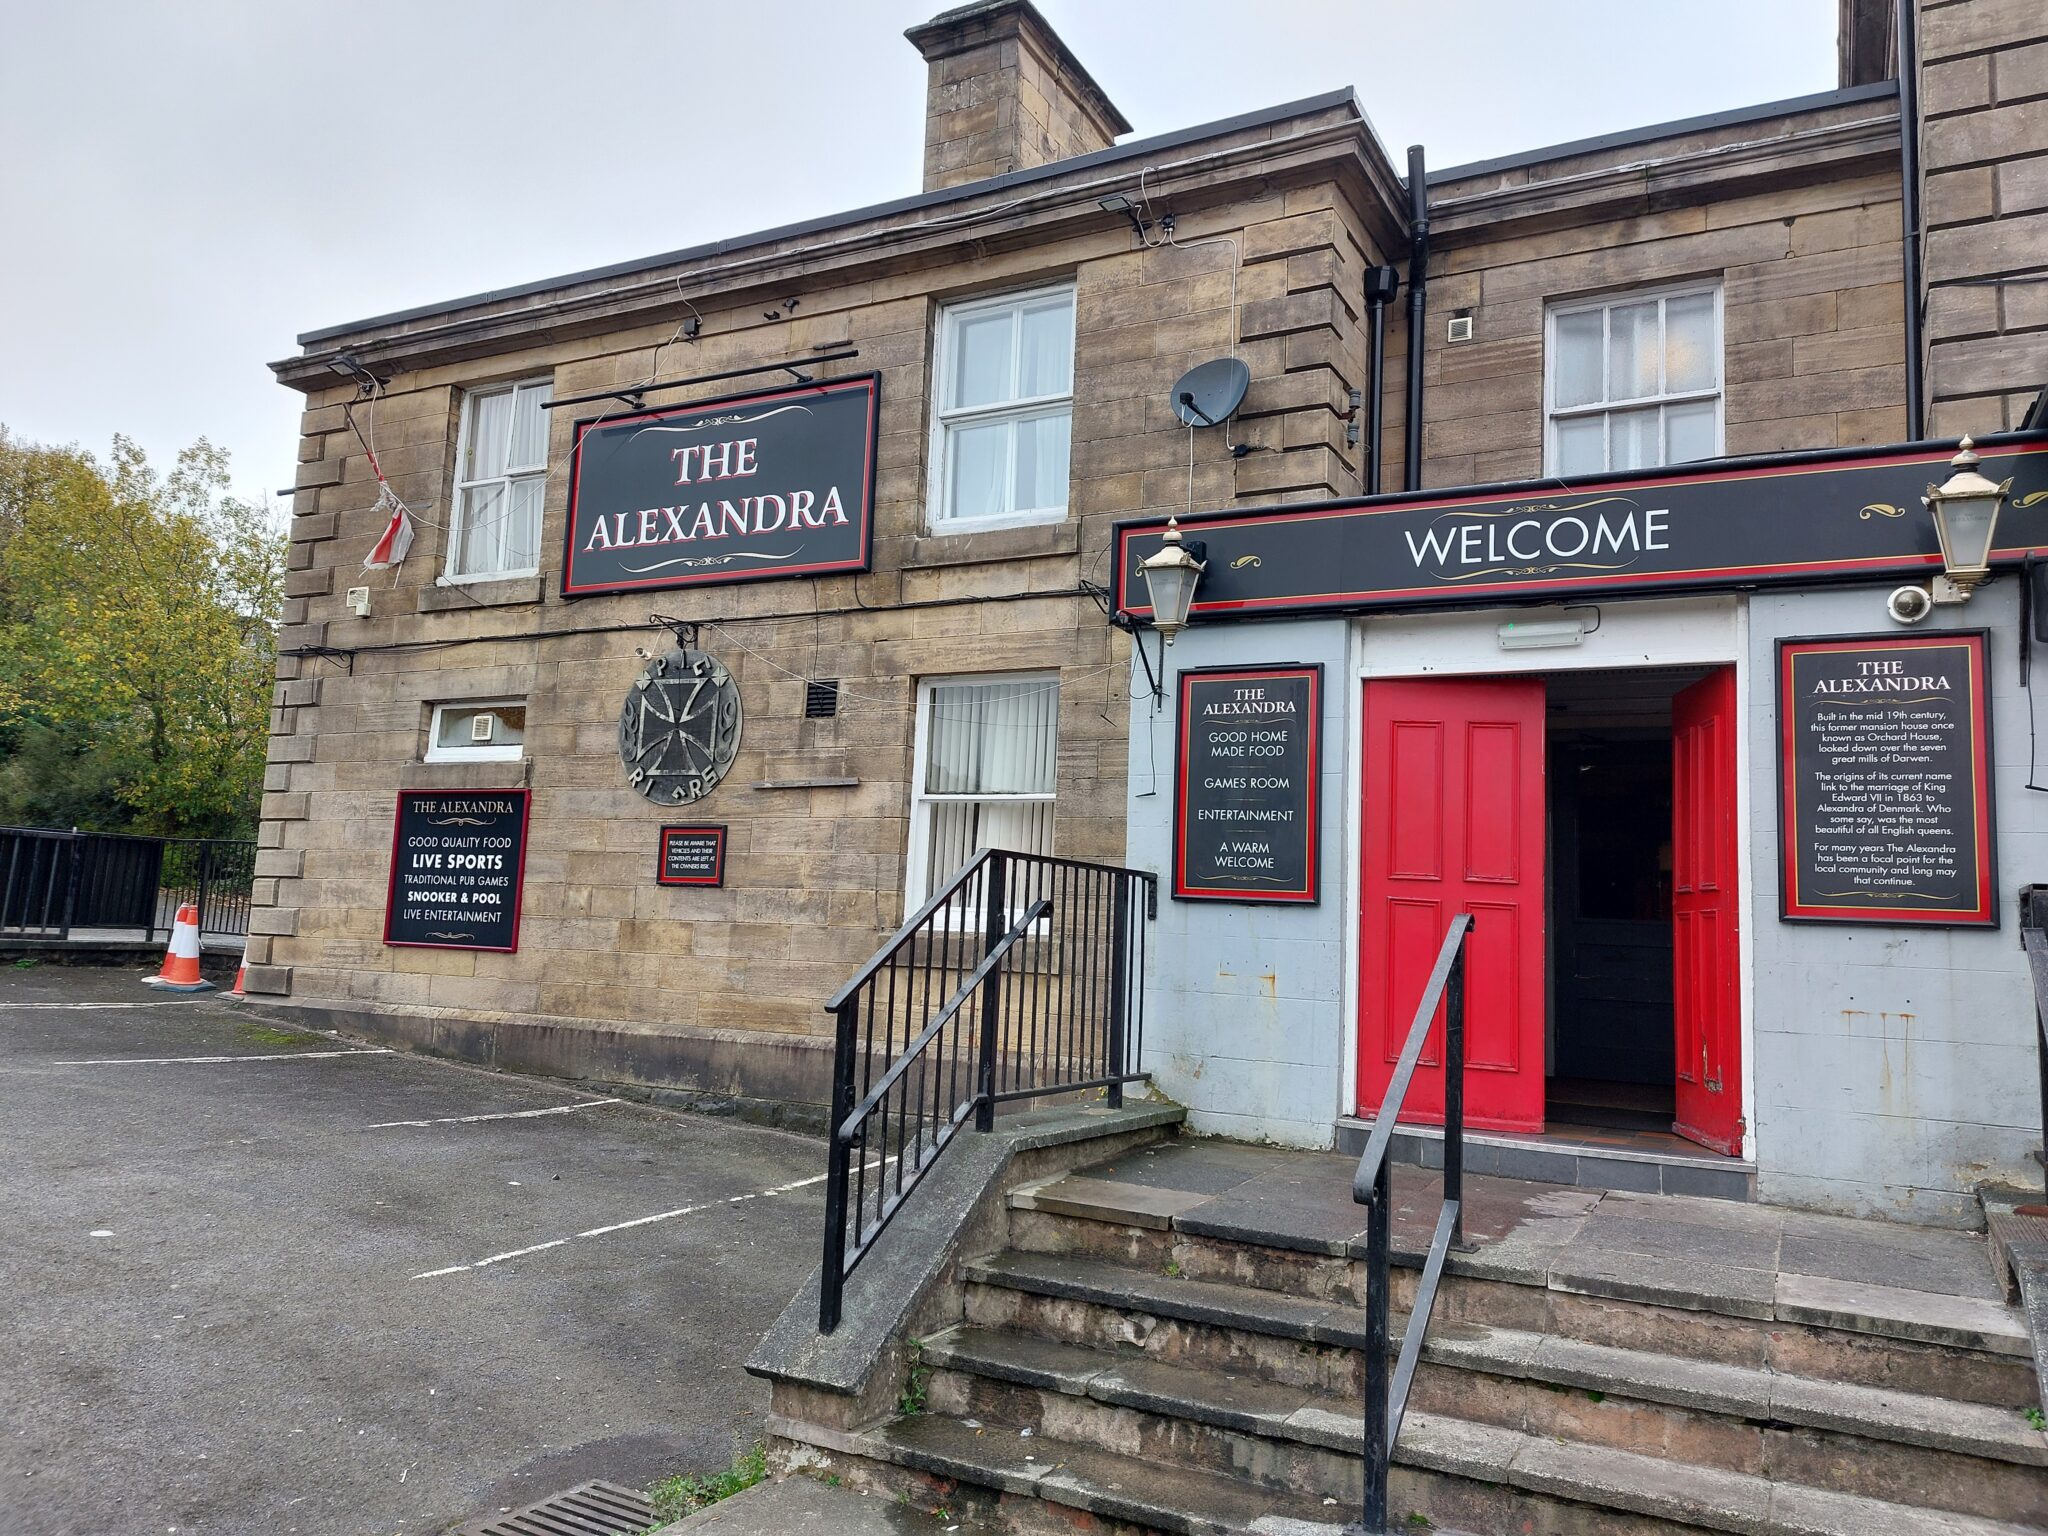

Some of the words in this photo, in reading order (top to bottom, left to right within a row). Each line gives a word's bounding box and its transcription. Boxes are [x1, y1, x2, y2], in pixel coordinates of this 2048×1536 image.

[671, 438, 758, 485] THE
[582, 486, 849, 552] ALEXANDRA
[1405, 509, 1670, 568] WELCOME
[1857, 660, 1904, 675] THE
[1812, 676, 1951, 694] ALEXANDRA
[1234, 688, 1265, 700] THE
[1202, 701, 1296, 715] ALEXANDRA
[1818, 712, 1836, 721] Built
[1839, 712, 1847, 720] in
[1850, 712, 1862, 720] the
[1866, 712, 1883, 720] mid
[1887, 711, 1907, 720] 19th
[1910, 711, 1946, 720] century,
[1810, 723, 1826, 731] this
[1828, 722, 1857, 731] former
[1860, 722, 1898, 730] mansion
[1901, 722, 1929, 730] house
[1931, 722, 1954, 730] once
[1209, 732, 1247, 743] GOOD
[1251, 731, 1288, 742] HOME
[1822, 734, 1852, 742] known
[1854, 734, 1865, 742] as
[1868, 733, 1907, 742] Orchard
[1910, 732, 1942, 742] House,
[1211, 746, 1245, 757] MADE
[1249, 745, 1284, 756] FOOD
[1819, 744, 1849, 752] looked
[1852, 744, 1878, 752] down
[1903, 744, 1917, 752] the
[1920, 744, 1946, 752] seven
[1832, 755, 1856, 765] great
[1858, 754, 1878, 763] mills
[1881, 754, 1890, 763] of
[1893, 754, 1933, 763] Darwen.
[1815, 772, 1831, 781] The
[1834, 772, 1864, 783] origins
[1867, 772, 1876, 780] of
[1878, 772, 1888, 780] its
[1891, 772, 1923, 780] current
[1204, 778, 1246, 789] GAMES
[1251, 778, 1289, 789] ROOM
[1821, 783, 1837, 791] link
[1839, 783, 1848, 791] to
[1850, 783, 1864, 791] the
[1867, 783, 1909, 793] marriage
[1912, 782, 1921, 791] of
[1924, 783, 1946, 793] King
[1832, 794, 1867, 802] Edward
[1870, 794, 1882, 802] VII
[1885, 794, 1893, 802] in
[1898, 794, 1922, 802] 1863
[1926, 794, 1935, 802] to
[413, 801, 436, 814] THE
[440, 801, 513, 814] ALEXANDRA
[1817, 804, 1864, 812] Alexandra
[1867, 804, 1876, 812] of
[1879, 804, 1923, 813] Denmark.
[1927, 804, 1951, 813] Who
[1198, 809, 1294, 822] ENTERTAINMENT
[1857, 816, 1874, 825] say,
[1899, 815, 1913, 823] the
[1916, 816, 1938, 824] most
[1815, 825, 1853, 834] beautiful
[1856, 826, 1866, 834] of
[1868, 826, 1879, 834] all
[1882, 826, 1914, 836] English
[1918, 828, 1954, 836] queens.
[408, 837, 438, 847] GOOD
[442, 838, 480, 848] QUALITY
[483, 838, 511, 848] FOOD
[1220, 842, 1228, 852] A
[1232, 842, 1269, 853] WARM
[1814, 843, 1828, 852] For
[1832, 845, 1856, 854] many
[1859, 846, 1884, 854] years
[1887, 843, 1903, 852] The
[1906, 844, 1956, 853] Alexandra
[413, 854, 442, 868] LIVE
[447, 855, 503, 869] SPORTS
[1215, 856, 1274, 868] WELCOME
[1818, 854, 1833, 862] has
[1836, 854, 1858, 862] been
[1871, 854, 1893, 863] focal
[1896, 856, 1920, 866] point
[1922, 855, 1936, 864] for
[1939, 856, 1953, 864] the
[1814, 864, 1836, 873] local
[1839, 865, 1888, 875] community
[1890, 866, 1909, 874] and
[1912, 866, 1932, 876] long
[1936, 868, 1957, 878] may
[404, 875, 456, 885] TRADITIONAL
[460, 876, 474, 885] PUB
[478, 876, 509, 886] GAMES
[1854, 876, 1870, 884] that
[1874, 876, 1915, 886] continue.
[407, 891, 457, 902] SNOOKER
[461, 893, 468, 903] &
[472, 893, 501, 904] POOL
[404, 909, 421, 920] LIVE
[424, 910, 501, 923] ENTERTAINMENT
